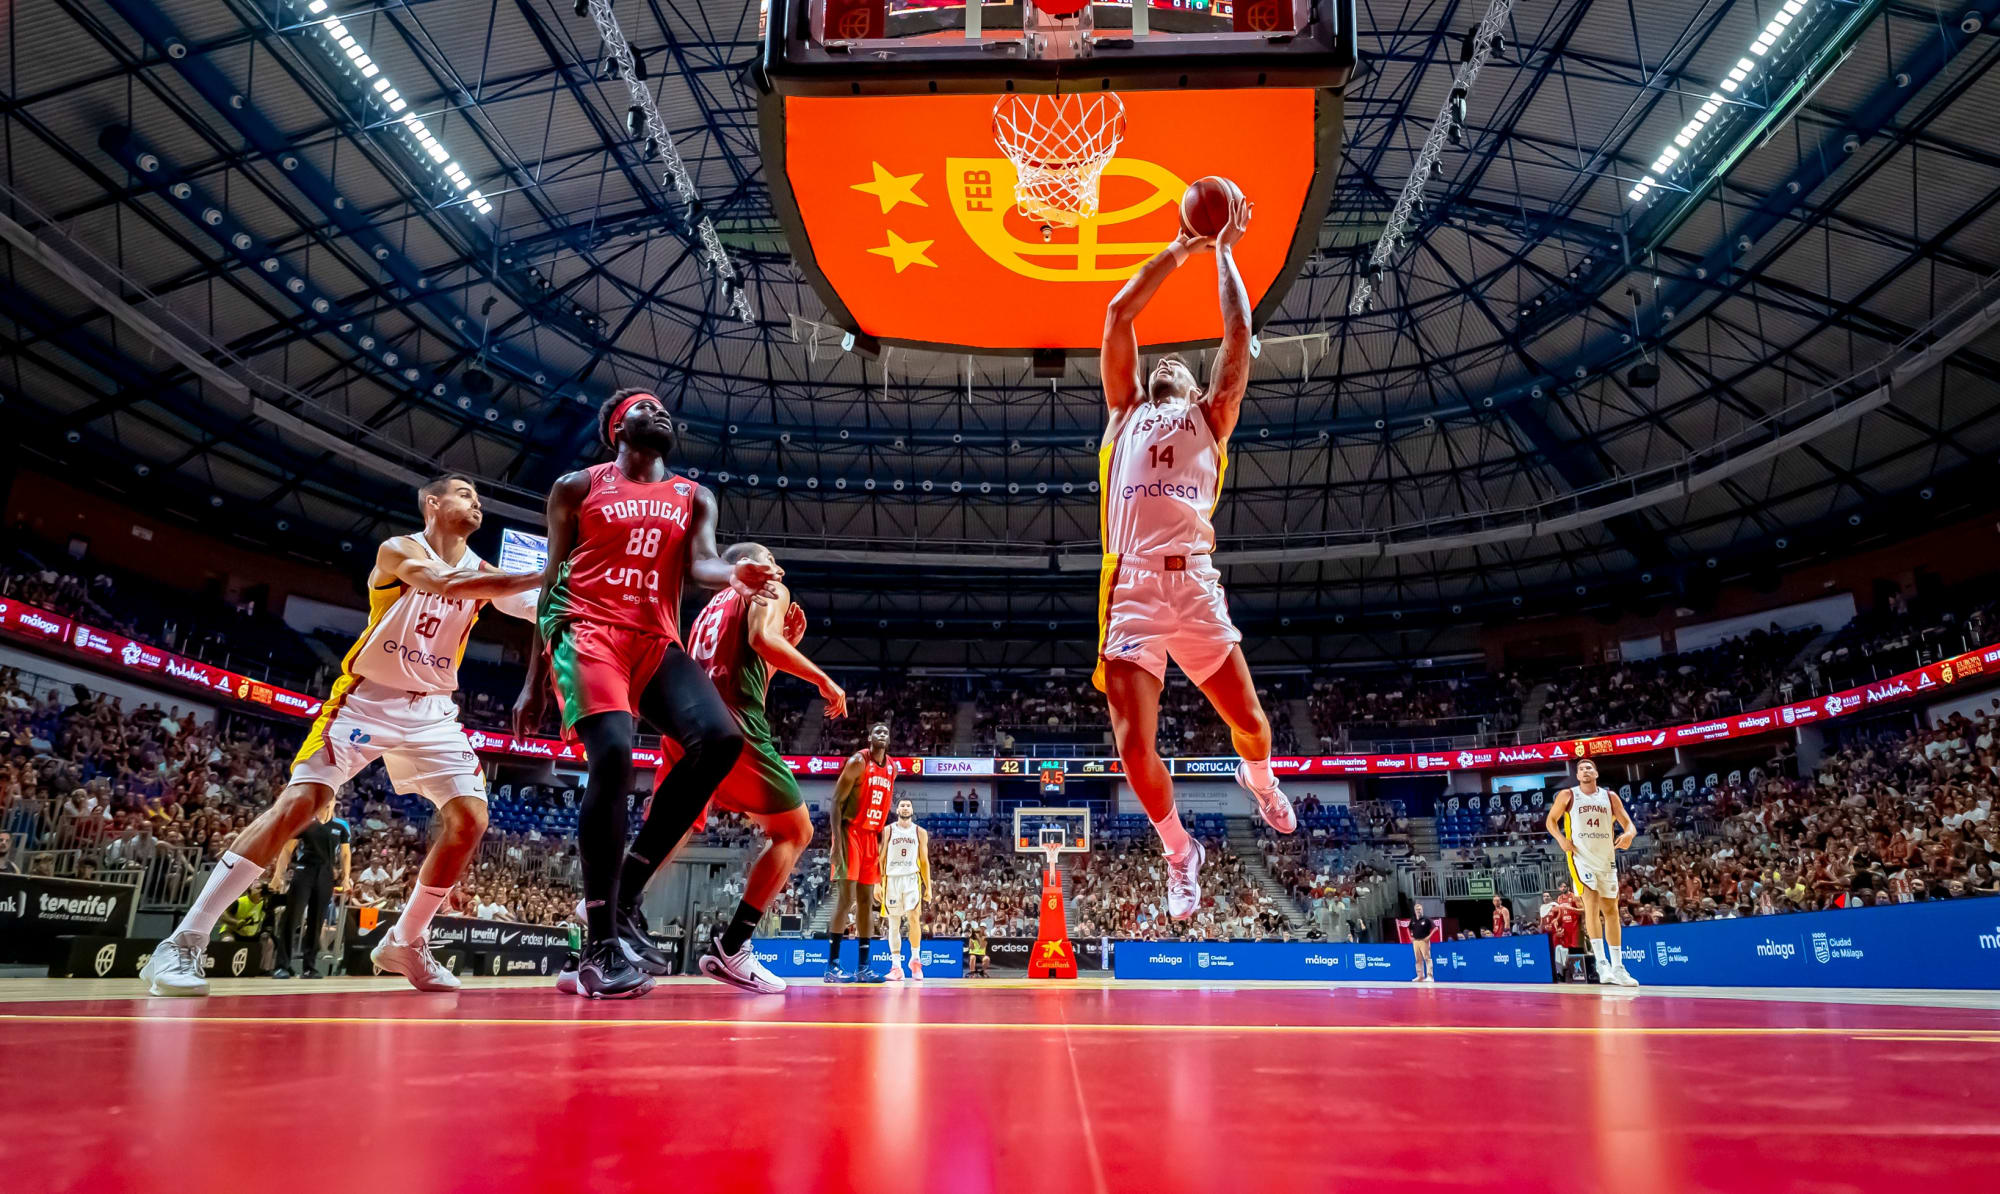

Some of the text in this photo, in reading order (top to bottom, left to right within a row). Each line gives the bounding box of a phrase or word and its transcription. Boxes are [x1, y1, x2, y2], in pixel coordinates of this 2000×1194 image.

[964, 170, 992, 211] FEB
[1148, 445, 1174, 468] 14
[1122, 480, 1198, 499] endesa
[601, 500, 689, 531] PORTUGAL
[625, 528, 661, 558] 88
[604, 567, 659, 591] una
[20, 613, 59, 634] málaga
[415, 612, 441, 639] 20
[275, 693, 308, 708] IBERIA
[1677, 722, 1728, 736] azulmarino
[1738, 716, 1770, 729] málaga
[1616, 735, 1652, 746] IBERIA
[632, 752, 654, 761] ERIA
[1322, 758, 1367, 766] azulmarino
[1377, 759, 1405, 767] málaga
[938, 761, 972, 772] ESPAÑA
[1001, 761, 1019, 773] 42
[1187, 762, 1235, 772] PORTUGAL
[1041, 771, 1064, 784] 4.5
[872, 790, 884, 805] 29
[1586, 818, 1600, 828] 44
[901, 848, 907, 857] 8
[39, 893, 117, 922] tenerife!
[521, 932, 544, 945] endesa
[1829, 937, 1852, 947] Ciudad
[991, 943, 1029, 952] endesa
[1621, 945, 1646, 963] málaga
[1756, 938, 1795, 959] málaga
[1832, 948, 1864, 960] de Málaga
[750, 951, 778, 962] álaga
[1149, 953, 1182, 965] málaga
[1305, 954, 1338, 967] málaga
[1036, 960, 1069, 969] CaixaBank
